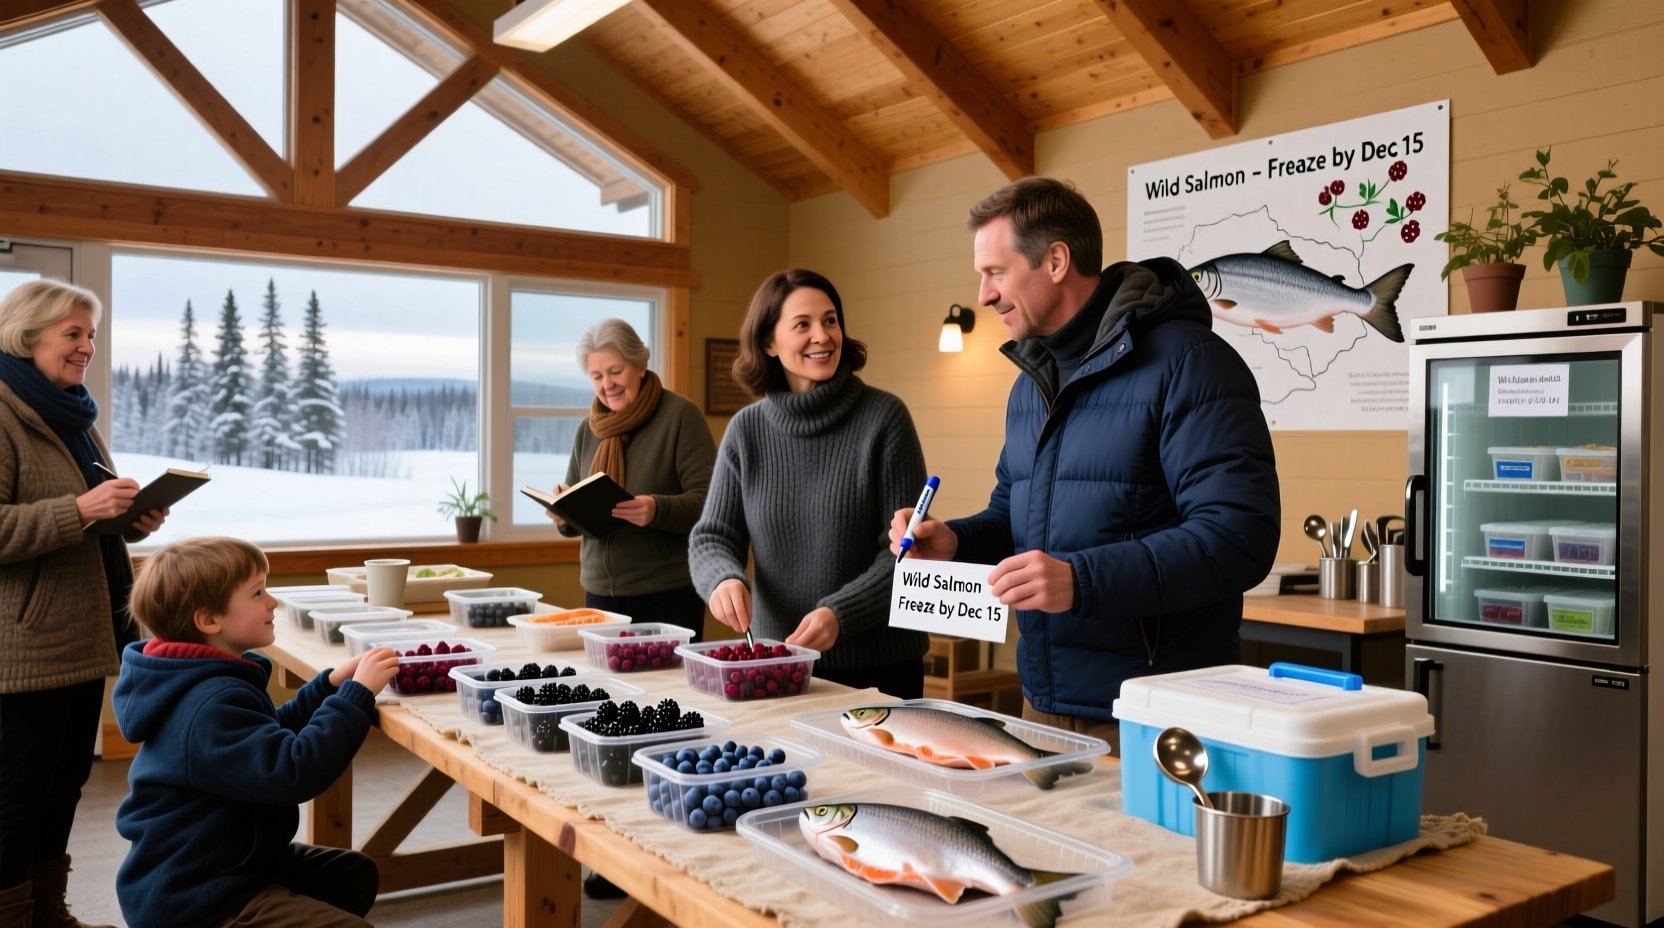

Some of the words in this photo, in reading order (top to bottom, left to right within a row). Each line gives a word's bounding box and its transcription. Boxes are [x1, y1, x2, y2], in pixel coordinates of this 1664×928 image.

[1145, 176, 1180, 201] Wild
[1185, 169, 1245, 194] Salmon
[1268, 154, 1327, 179] Freaze
[1332, 146, 1356, 171] by
[1361, 141, 1398, 163] Dec
[1402, 131, 1424, 156] 15
[903, 571, 931, 589] Wild
[933, 574, 982, 594] Salmon
[938, 599, 955, 619] by
[957, 602, 983, 619] Dec
[986, 605, 1002, 622] 15
